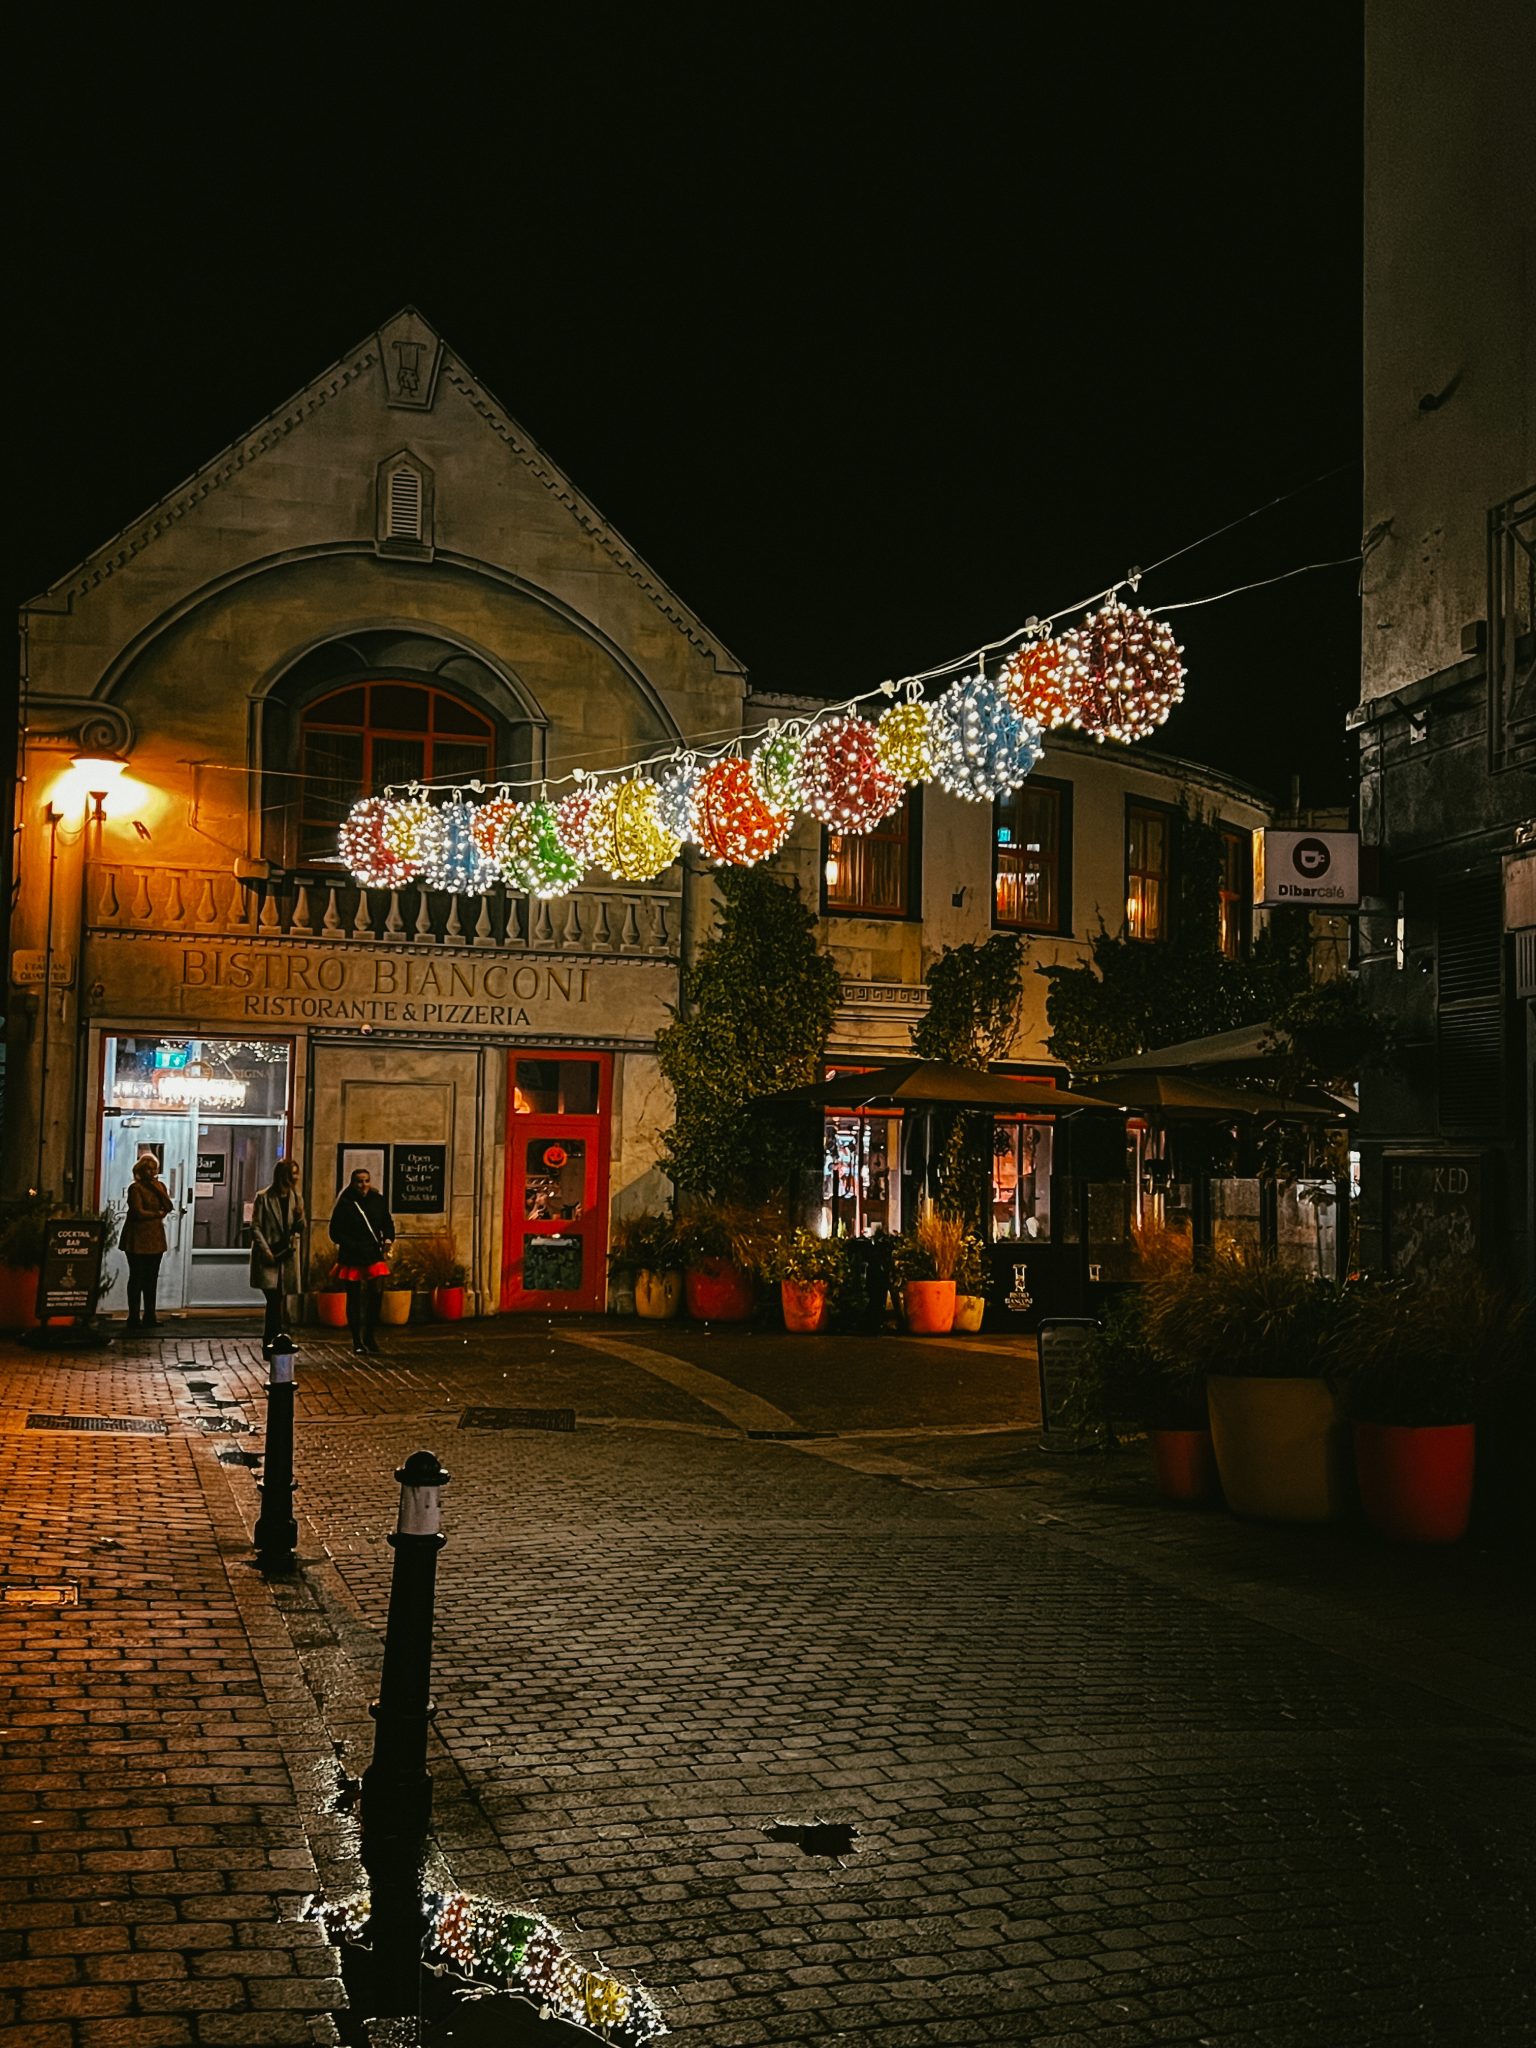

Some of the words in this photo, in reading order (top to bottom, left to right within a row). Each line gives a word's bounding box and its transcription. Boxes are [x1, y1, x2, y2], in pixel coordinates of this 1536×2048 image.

[179, 948, 347, 994] BISTRO
[371, 959, 592, 1004] BIANCONI
[243, 994, 399, 1022] RISTORANTE
[423, 1003, 532, 1027] PIZZERIA
